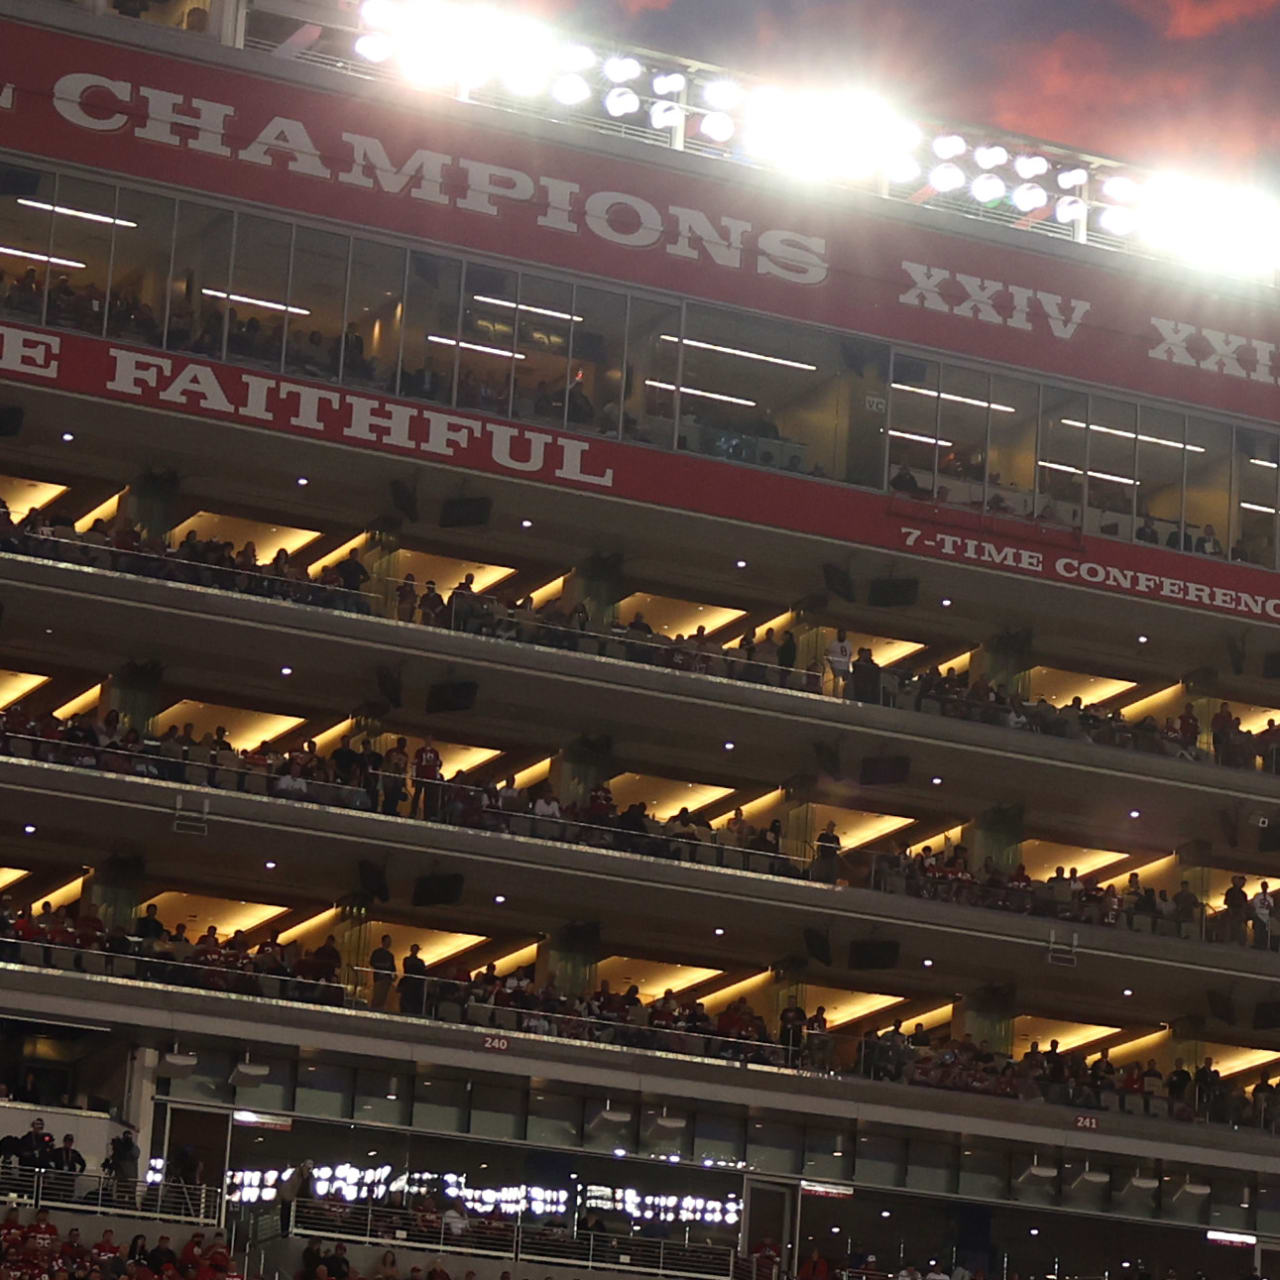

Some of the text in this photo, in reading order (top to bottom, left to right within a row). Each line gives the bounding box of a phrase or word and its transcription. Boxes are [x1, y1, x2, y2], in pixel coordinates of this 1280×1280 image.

[53, 73, 831, 287] CHAMPIONS
[900, 261, 1091, 339] XXIV
[106, 348, 614, 488] FAITHFUL
[901, 527, 1044, 571] 7-TIME
[484, 1038, 508, 1050] 240
[1077, 1116, 1098, 1128] 241
